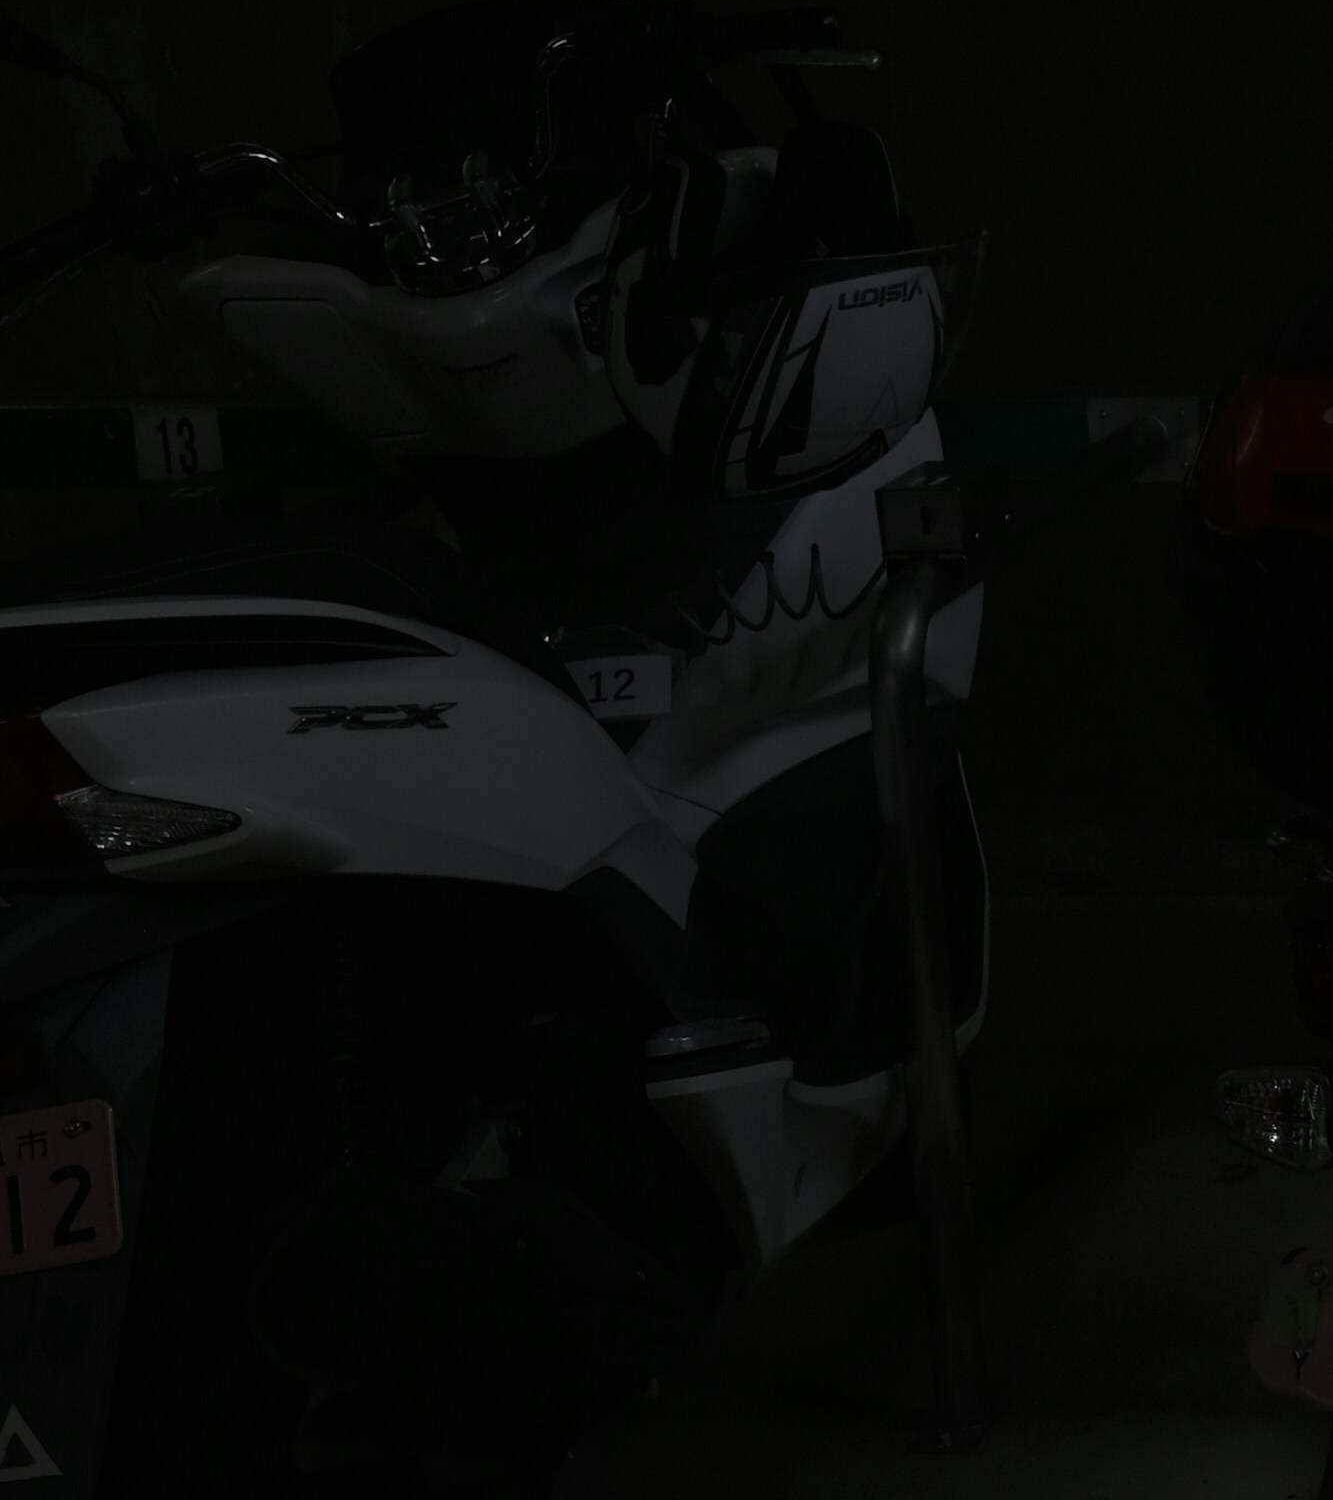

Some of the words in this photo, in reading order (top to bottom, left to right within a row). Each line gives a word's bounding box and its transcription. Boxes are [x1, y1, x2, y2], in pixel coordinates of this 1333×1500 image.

[156, 417, 198, 474] 13
[588, 668, 636, 704] 12
[286, 702, 458, 734] PCX
[0, 1130, 48, 1166] 市
